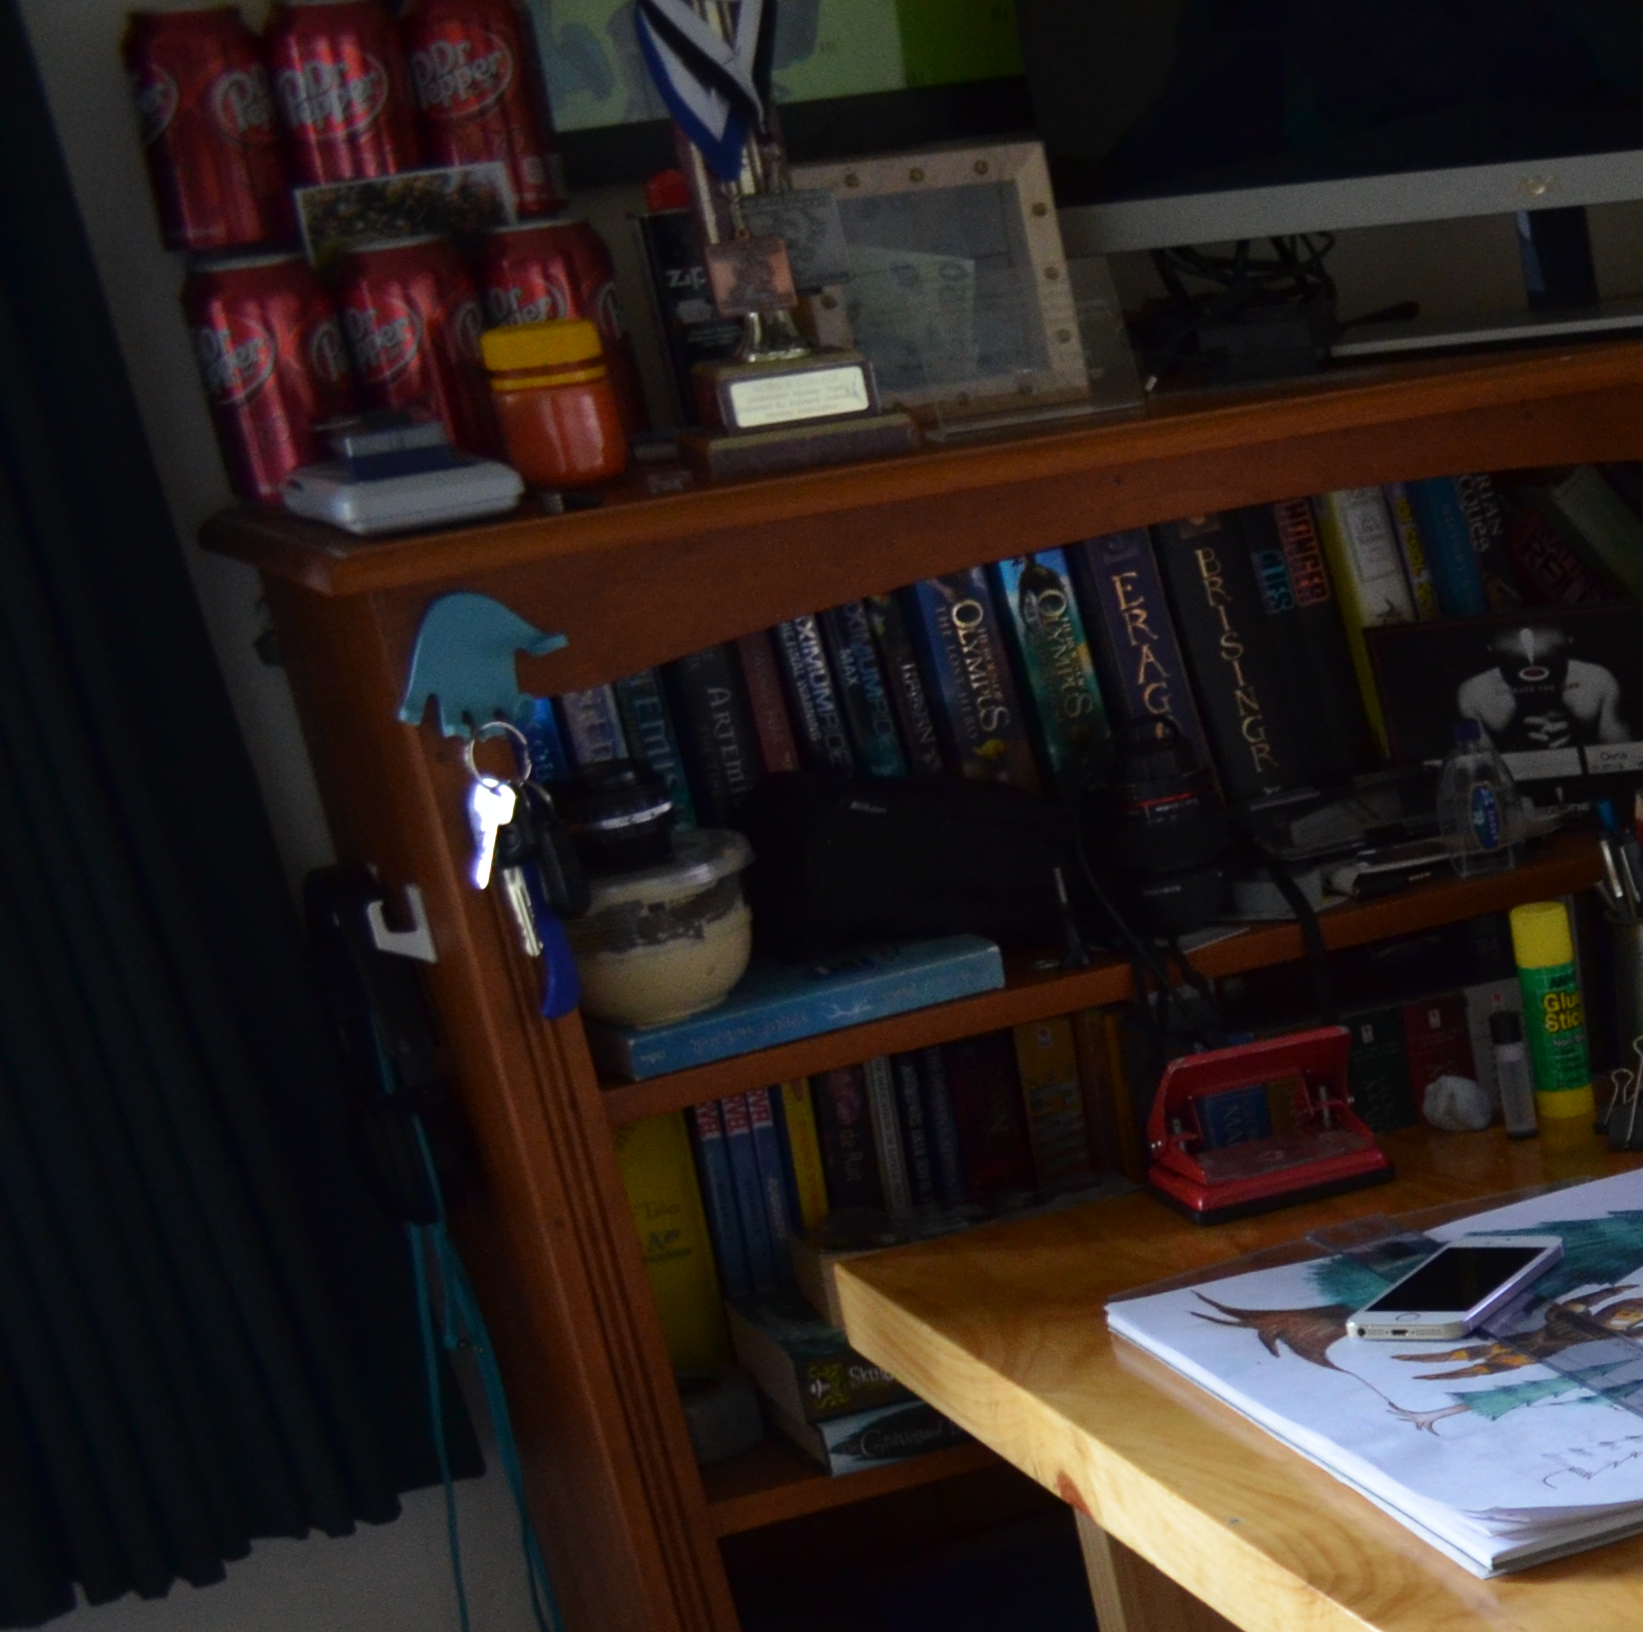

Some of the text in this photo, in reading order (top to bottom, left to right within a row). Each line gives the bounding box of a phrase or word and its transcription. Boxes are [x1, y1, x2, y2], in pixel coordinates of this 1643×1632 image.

[304, 59, 349, 99] Dr
[411, 50, 501, 112] Pepper
[430, 39, 472, 76] Dr
[1475, 473, 1504, 537] RIAN
[936, 606, 949, 636] THE
[795, 615, 837, 716] XIMUM
[839, 648, 861, 687] MAX
[843, 601, 886, 706] XIMUM
[952, 599, 1011, 733] OLYMPUS
[1038, 588, 1094, 719] OLYMPUS
[1111, 571, 1181, 741] ERAG
[1194, 546, 1280, 775] BRISINGR
[1544, 1010, 1583, 1033] Stic
